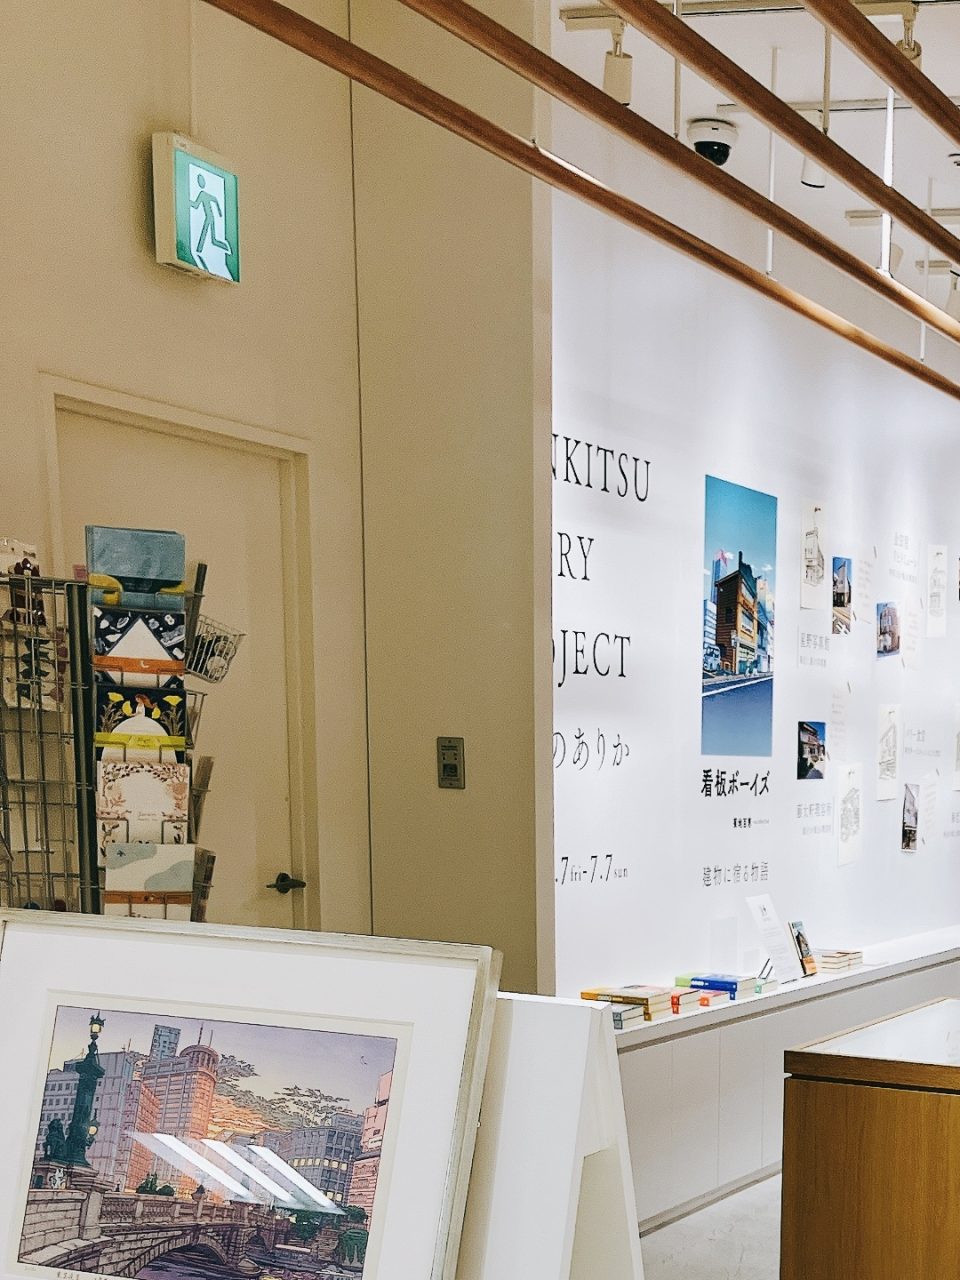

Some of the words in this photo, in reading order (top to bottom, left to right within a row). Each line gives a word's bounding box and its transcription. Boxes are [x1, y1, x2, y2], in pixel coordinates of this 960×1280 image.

[558, 532, 594, 580] RY
[552, 630, 630, 687] JECT
[701, 769, 770, 797] 看板ボーイズ
